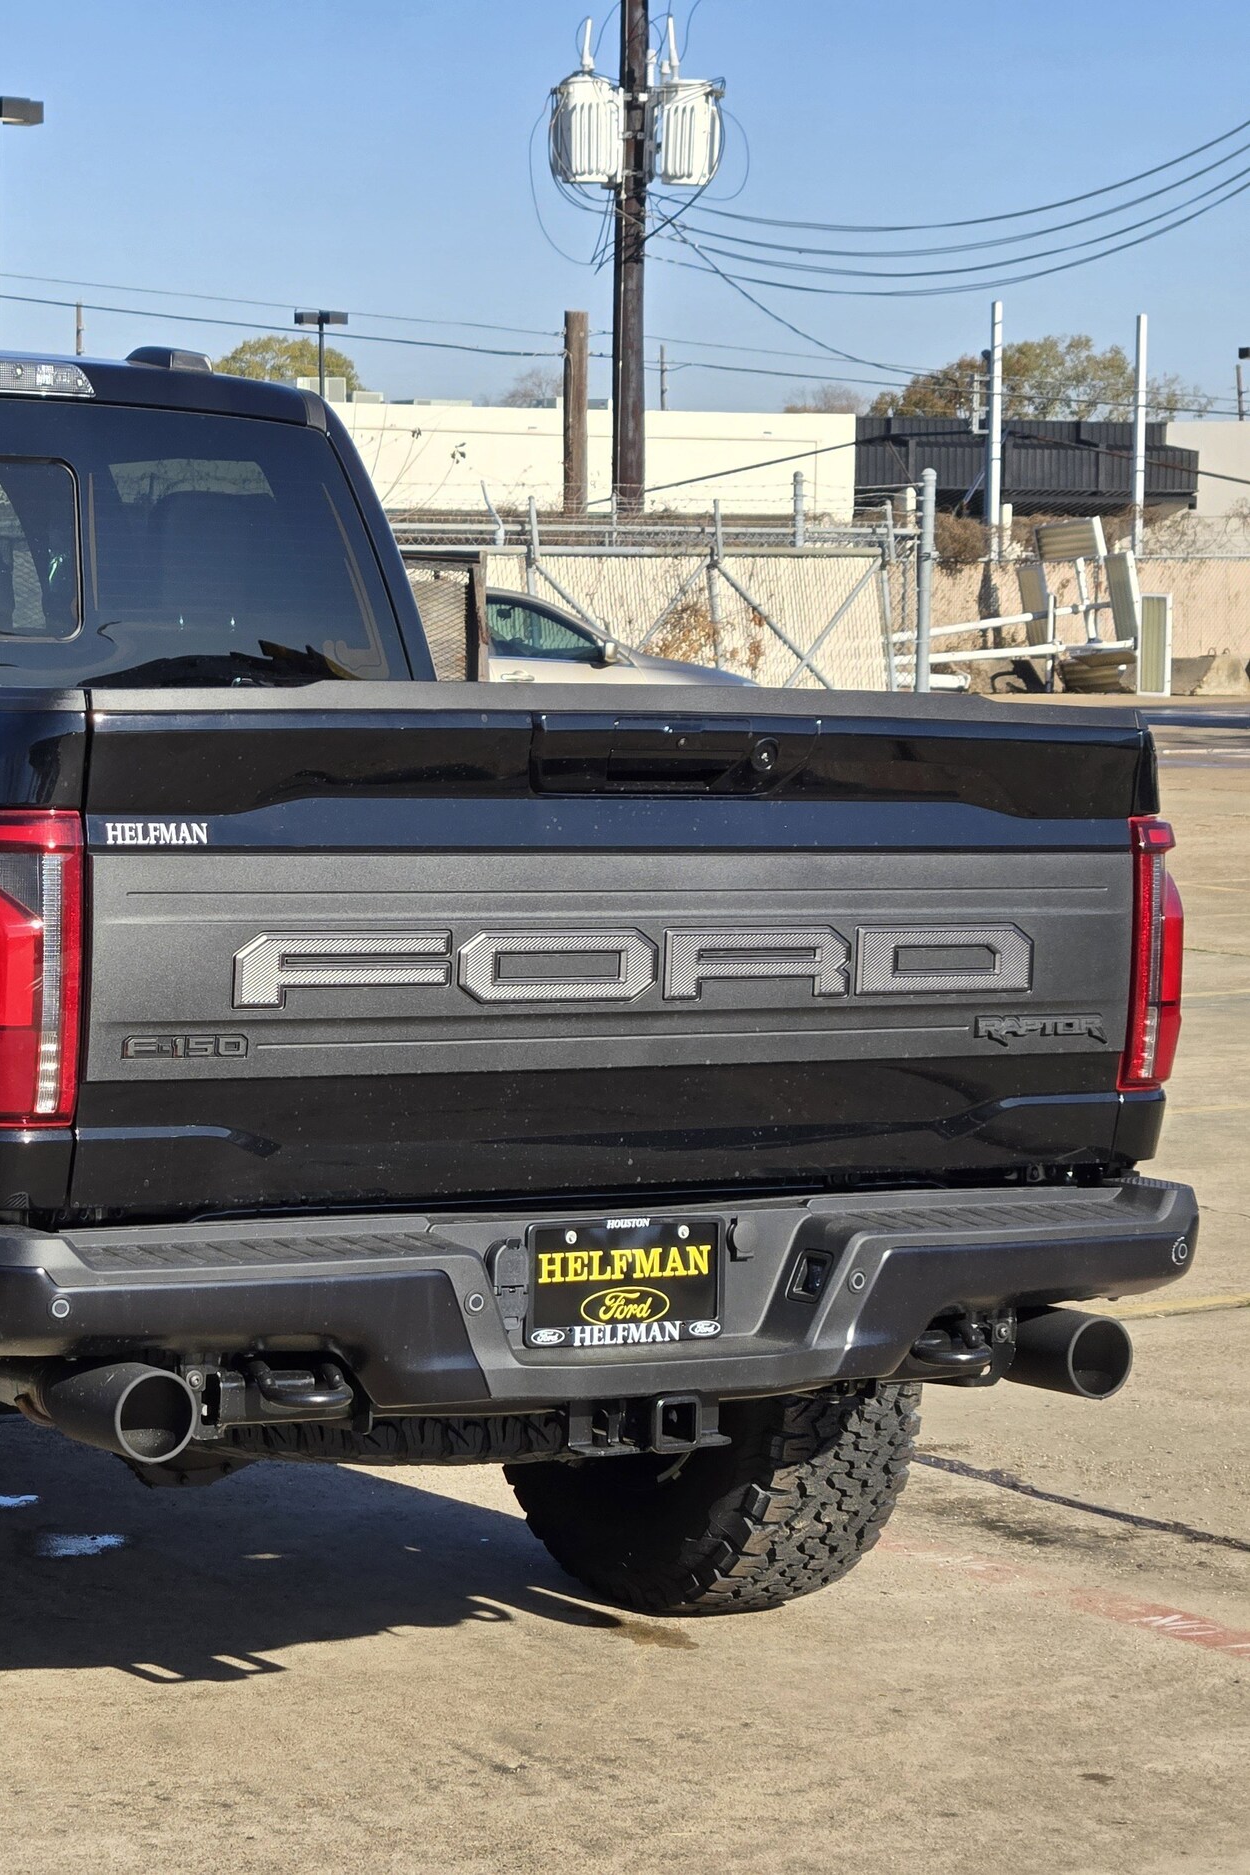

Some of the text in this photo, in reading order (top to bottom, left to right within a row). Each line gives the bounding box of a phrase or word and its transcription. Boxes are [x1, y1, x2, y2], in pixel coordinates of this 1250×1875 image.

[105, 822, 208, 844] HELFMAN
[232, 922, 1034, 1009] FORD
[973, 1013, 1108, 1047] RAPTOR
[606, 1218, 650, 1229] HOUSTON
[538, 1245, 711, 1283] HELFMAN
[599, 1291, 652, 1320] Ford
[535, 1320, 718, 1346] Ford HELFMAN Ford
